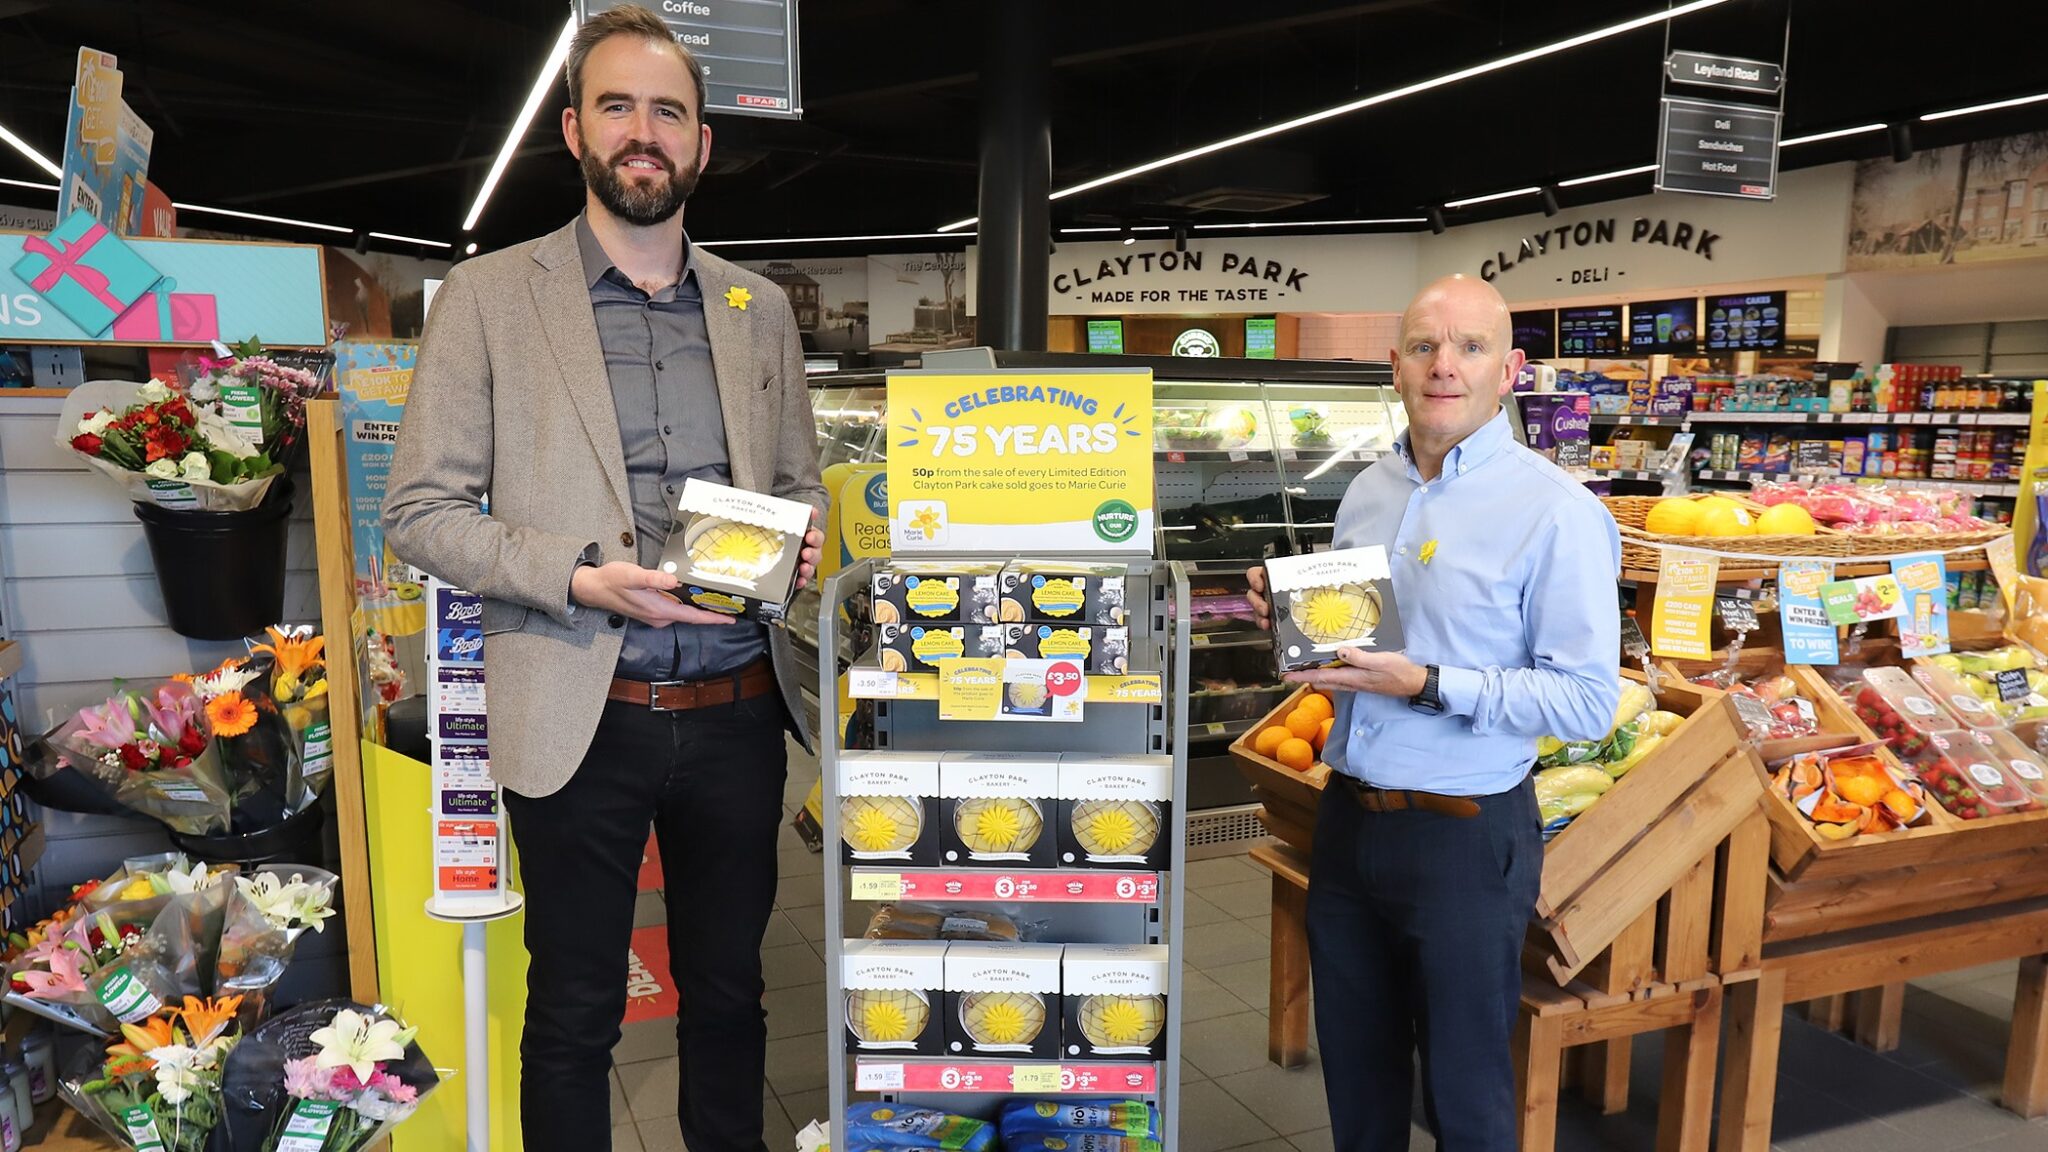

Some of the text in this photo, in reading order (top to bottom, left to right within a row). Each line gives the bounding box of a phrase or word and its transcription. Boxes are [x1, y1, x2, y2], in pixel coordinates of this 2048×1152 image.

[663, 1, 711, 16] Coffee
[1694, 63, 1760, 81] Leyland Road
[745, 97, 776, 106] SPAR
[1715, 120, 1731, 130] Deli
[1698, 140, 1744, 152] Sandwiches
[1702, 162, 1737, 173] Hot Food
[1480, 217, 1722, 283] CLAYTON PARK
[765, 265, 843, 275] Pleasant Retreat
[903, 261, 922, 272] The
[1053, 250, 1310, 294] CLAYTON PARK
[1091, 288, 1268, 304] MADE FOR THE TASTE
[1745, 296, 1771, 305] CAKES
[393, 373, 410, 383] TO
[944, 384, 1099, 419] CELEBRATING
[356, 432, 379, 441] WIN
[925, 421, 1119, 458] 75 YEARS
[912, 467, 1126, 481] 50p from the sale of every Limited Edition
[913, 480, 1126, 492] Clayton Park cake sold goes to Marie Curie
[712, 496, 777, 516] CLAYTON PARK
[1097, 512, 1135, 522] NURTURE
[1297, 562, 1334, 575] CLAYTON
[1793, 607, 1817, 616] ENTER
[1789, 615, 1829, 626] WIN PRIZES
[1790, 638, 1832, 650] TO WIN!
[953, 667, 992, 676] CELEBRATING
[950, 676, 997, 685] 75 YEARS
[1047, 671, 1079, 686] £3.50
[1120, 679, 1159, 689] CELEBRATING
[1116, 689, 1129, 698] 75
[446, 722, 486, 731] Ultimate
[849, 771, 909, 783] CLAYTON PARK
[968, 773, 1029, 785] CLAYTON PARK
[1086, 775, 1147, 787] CLAYTON PARK
[448, 798, 488, 807] Ultimate
[452, 873, 480, 883] Home
[1000, 882, 1038, 895] 3 £3.50
[1121, 883, 1132, 894] 3
[856, 966, 915, 977] CLAYTON PARK
[972, 968, 1031, 979] CLAYTON PARK
[1091, 971, 1151, 982] CLAYTON PARK
[102, 973, 128, 1000] FLOWERS
[946, 1073, 983, 1086] 3 £3.50
[1061, 1074, 1098, 1086] 3 £3.50
[1125, 1074, 1143, 1082] VALUE
[299, 1107, 333, 1115] FLOWERS
